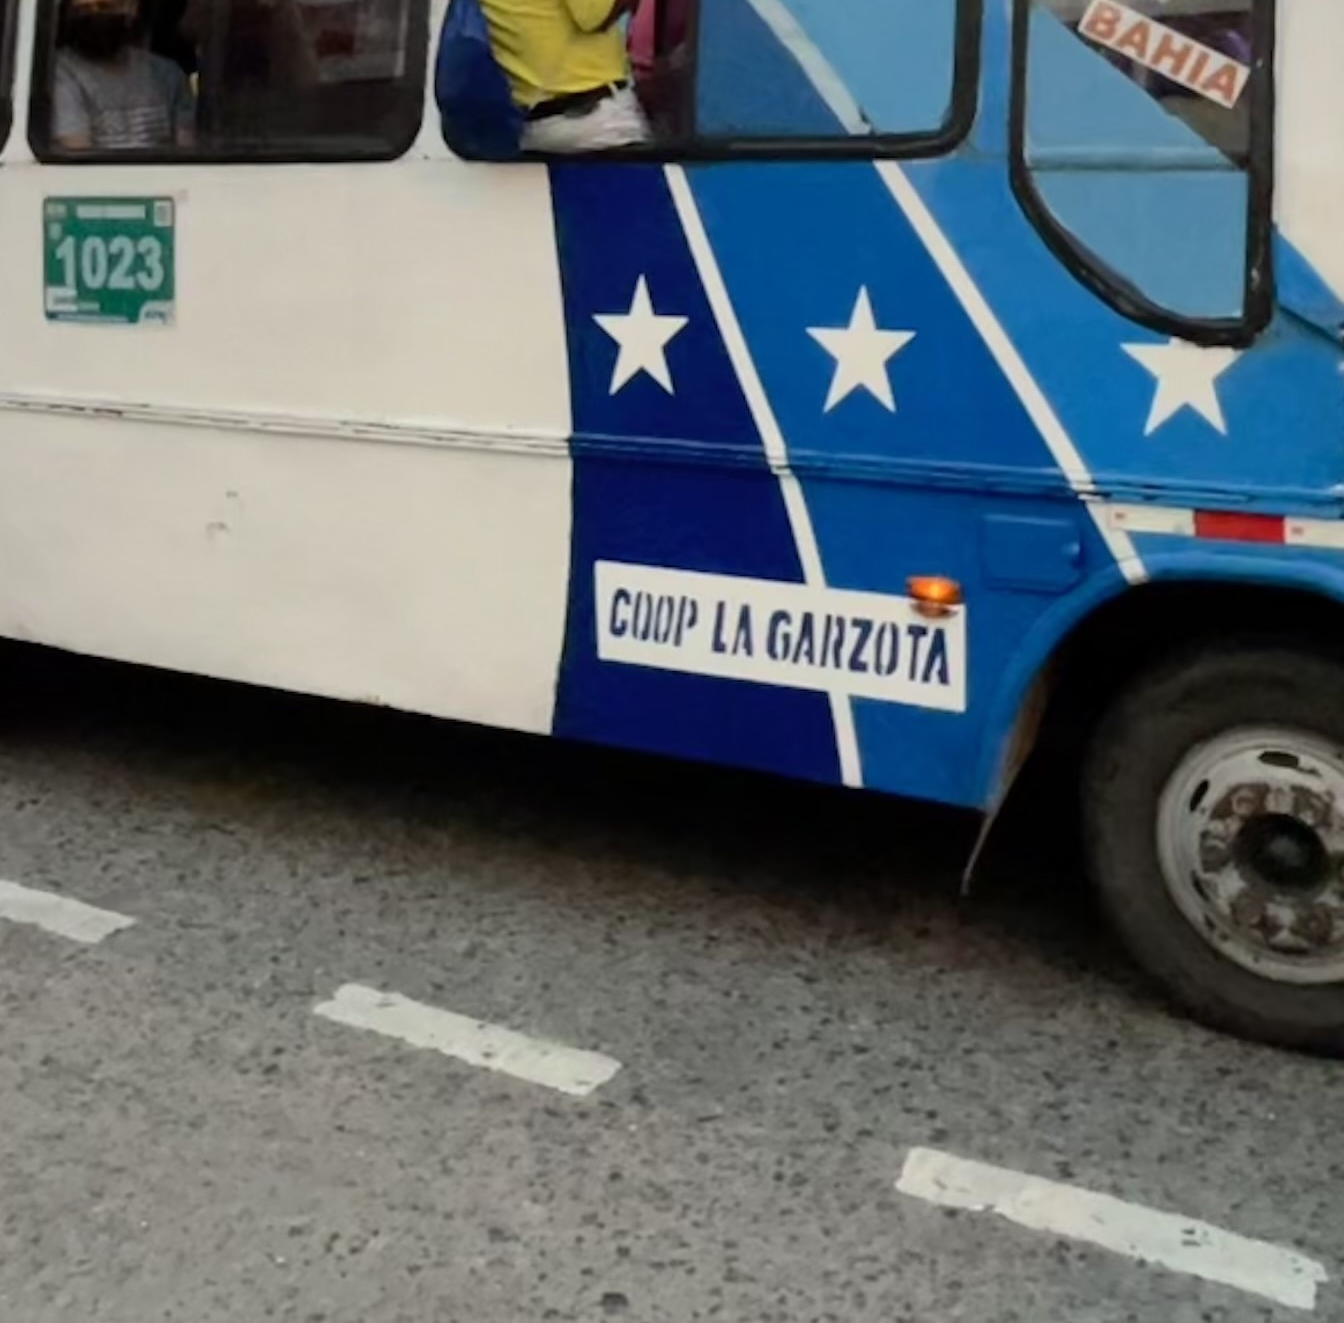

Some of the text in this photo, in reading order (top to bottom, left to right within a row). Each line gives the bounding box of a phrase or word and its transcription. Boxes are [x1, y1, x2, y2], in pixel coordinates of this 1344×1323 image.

[1084, 2, 1240, 102] BAHIA
[55, 234, 165, 292] 1023
[609, 587, 951, 687] COOP LA GARZOTA
